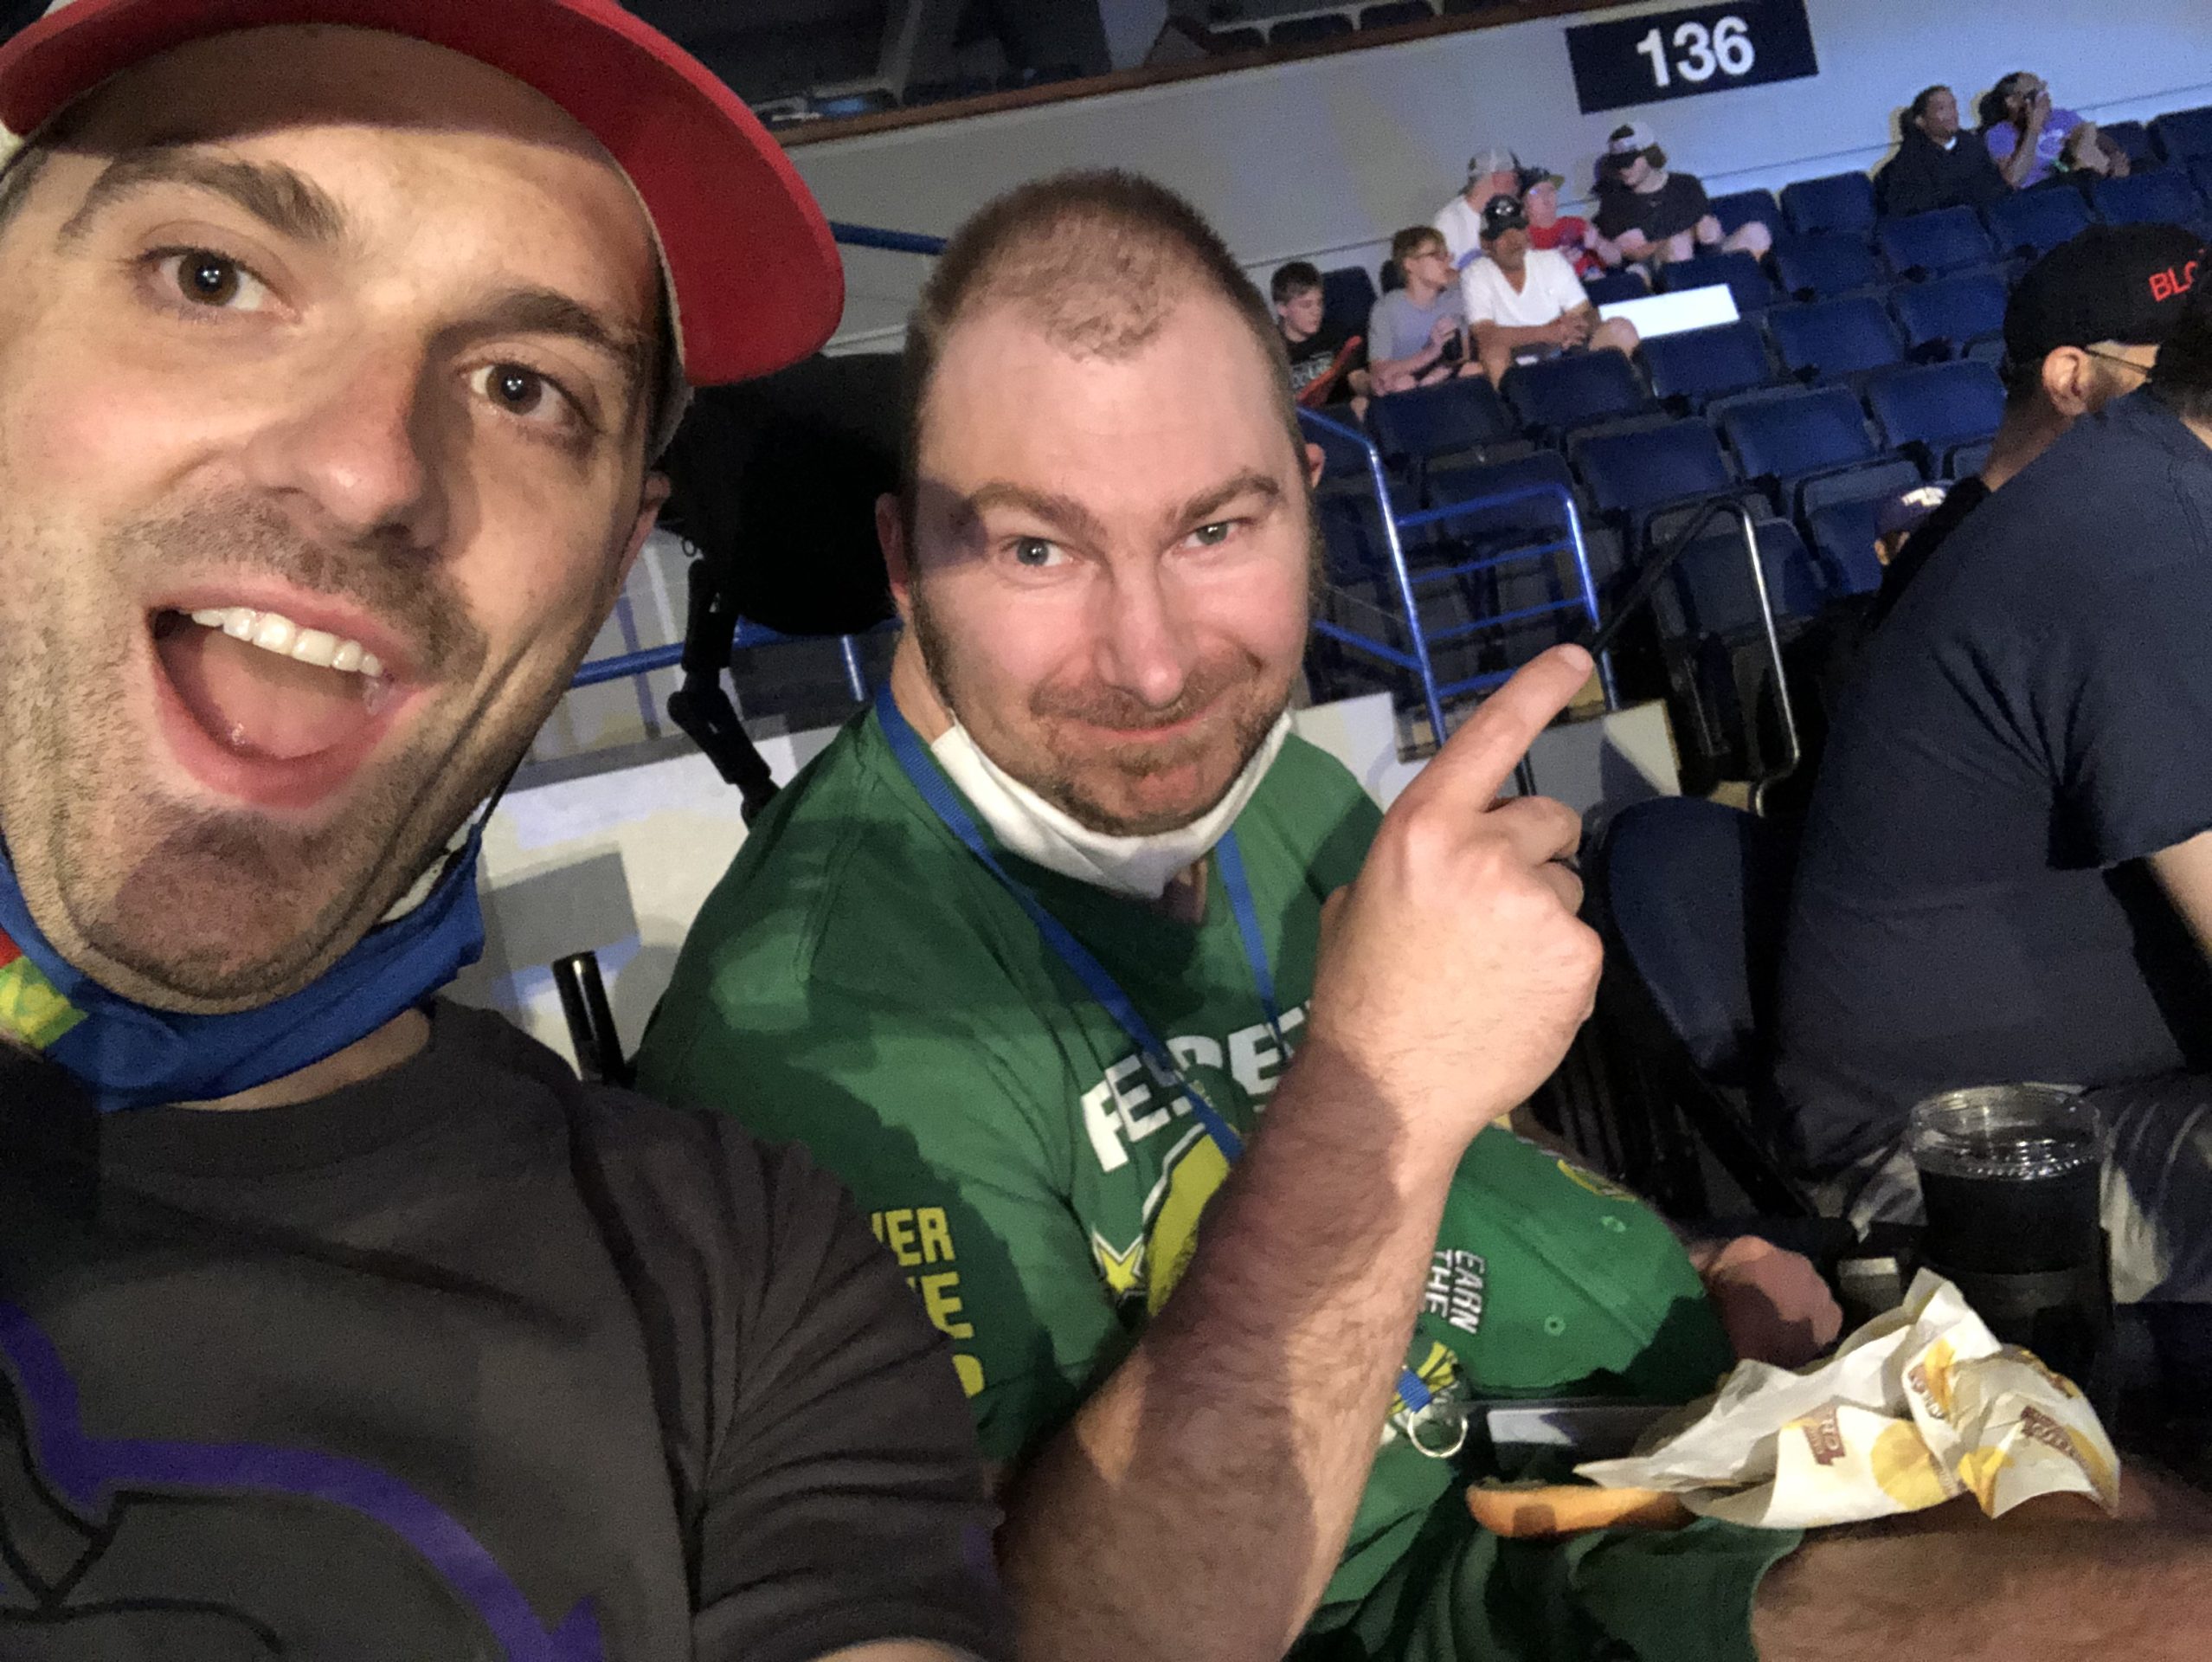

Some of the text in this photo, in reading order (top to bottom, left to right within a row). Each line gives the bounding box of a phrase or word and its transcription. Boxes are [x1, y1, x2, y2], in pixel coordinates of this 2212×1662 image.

[1636, 16, 1755, 87] 136
[1424, 1249, 1453, 1317] THE
[1449, 1250, 1486, 1334] EARN
